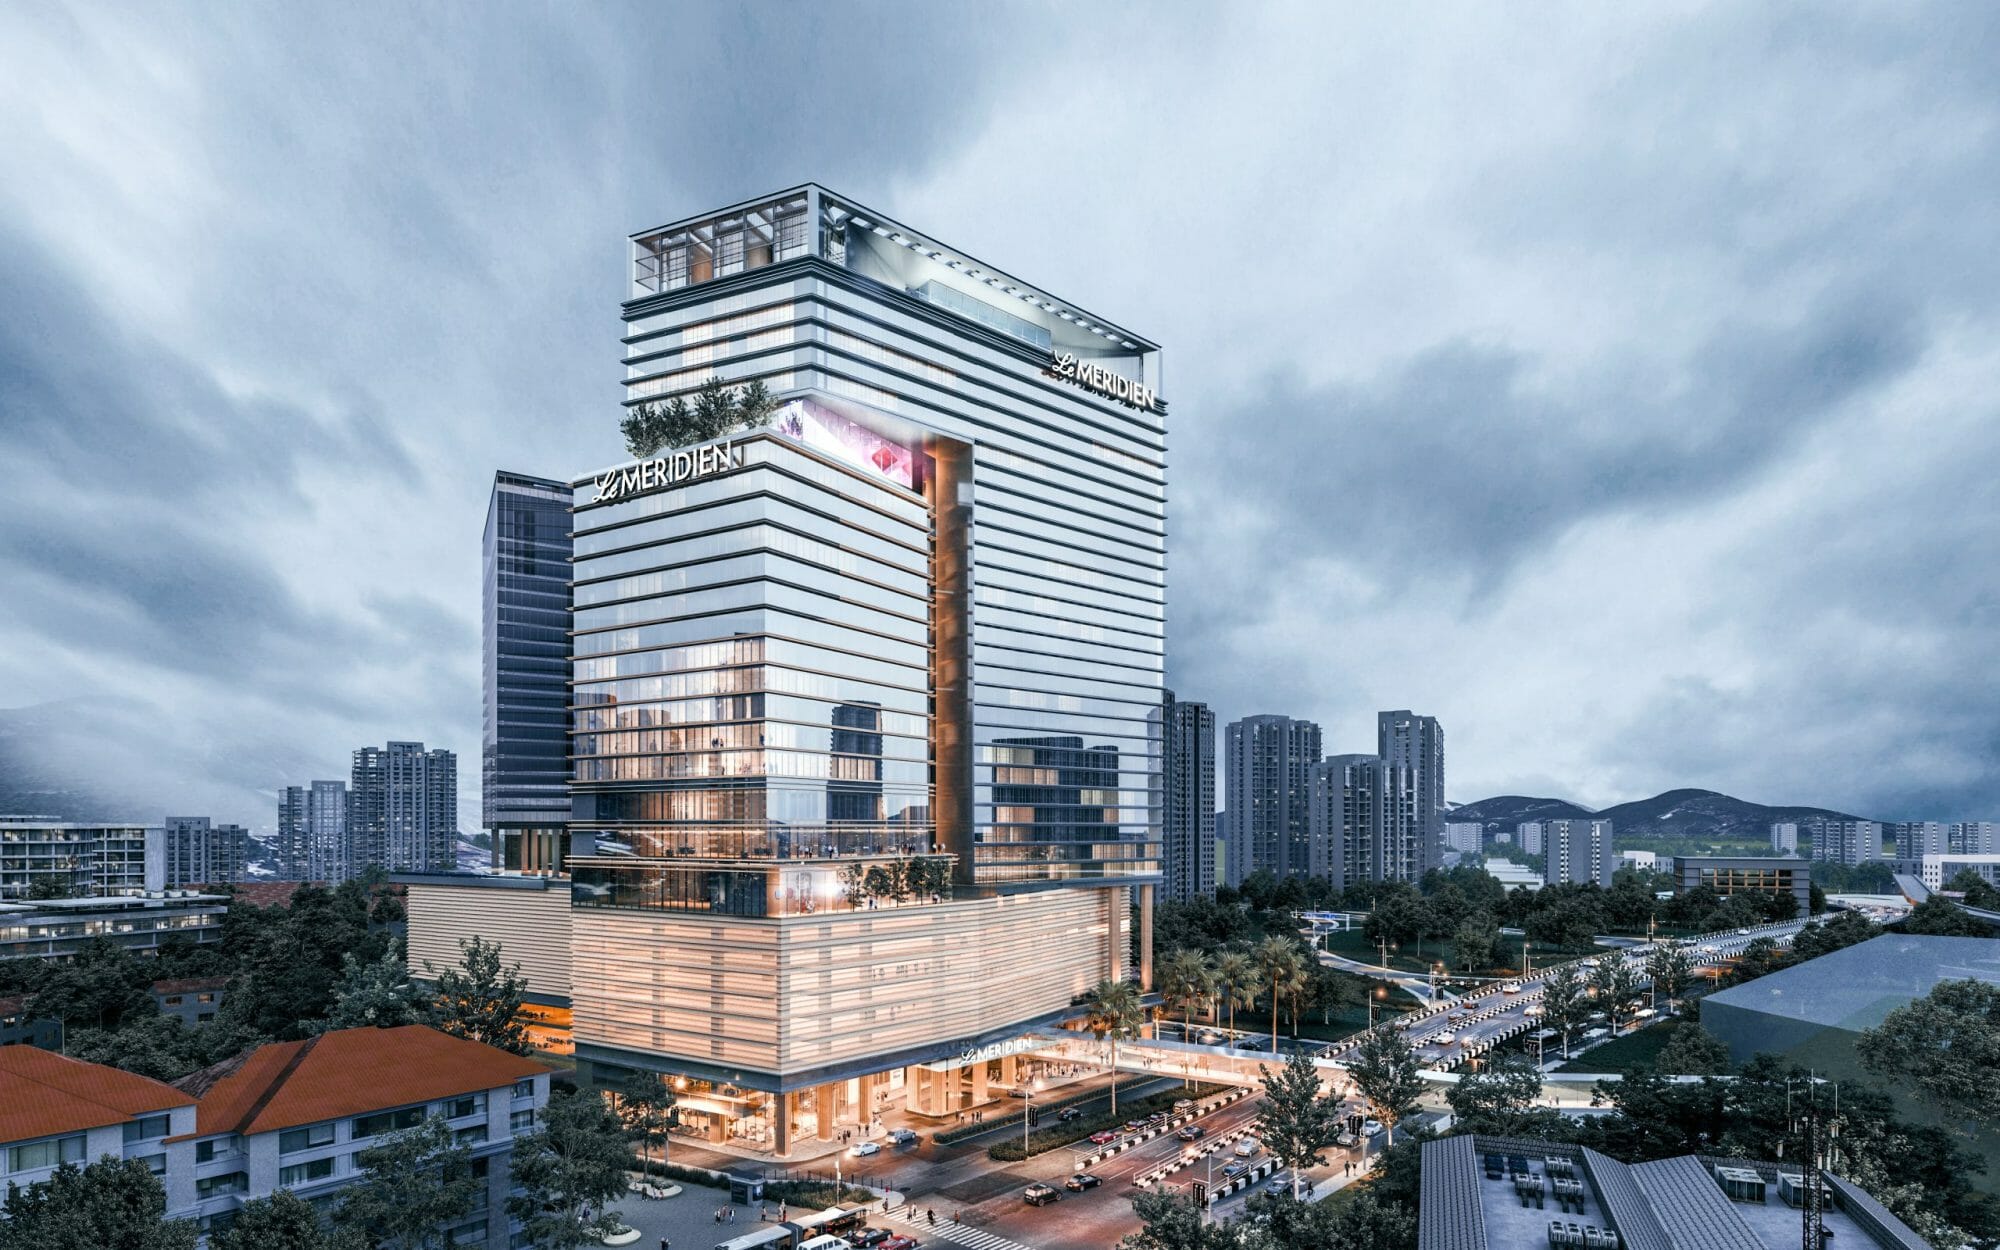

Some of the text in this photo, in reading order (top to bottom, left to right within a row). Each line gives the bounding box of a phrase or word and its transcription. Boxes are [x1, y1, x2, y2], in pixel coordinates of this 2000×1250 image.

[1052, 350, 1154, 409] Le MERIDIEN
[592, 440, 732, 503] Le MERIDIEN
[977, 1037, 1032, 1060] MERIDIEN
